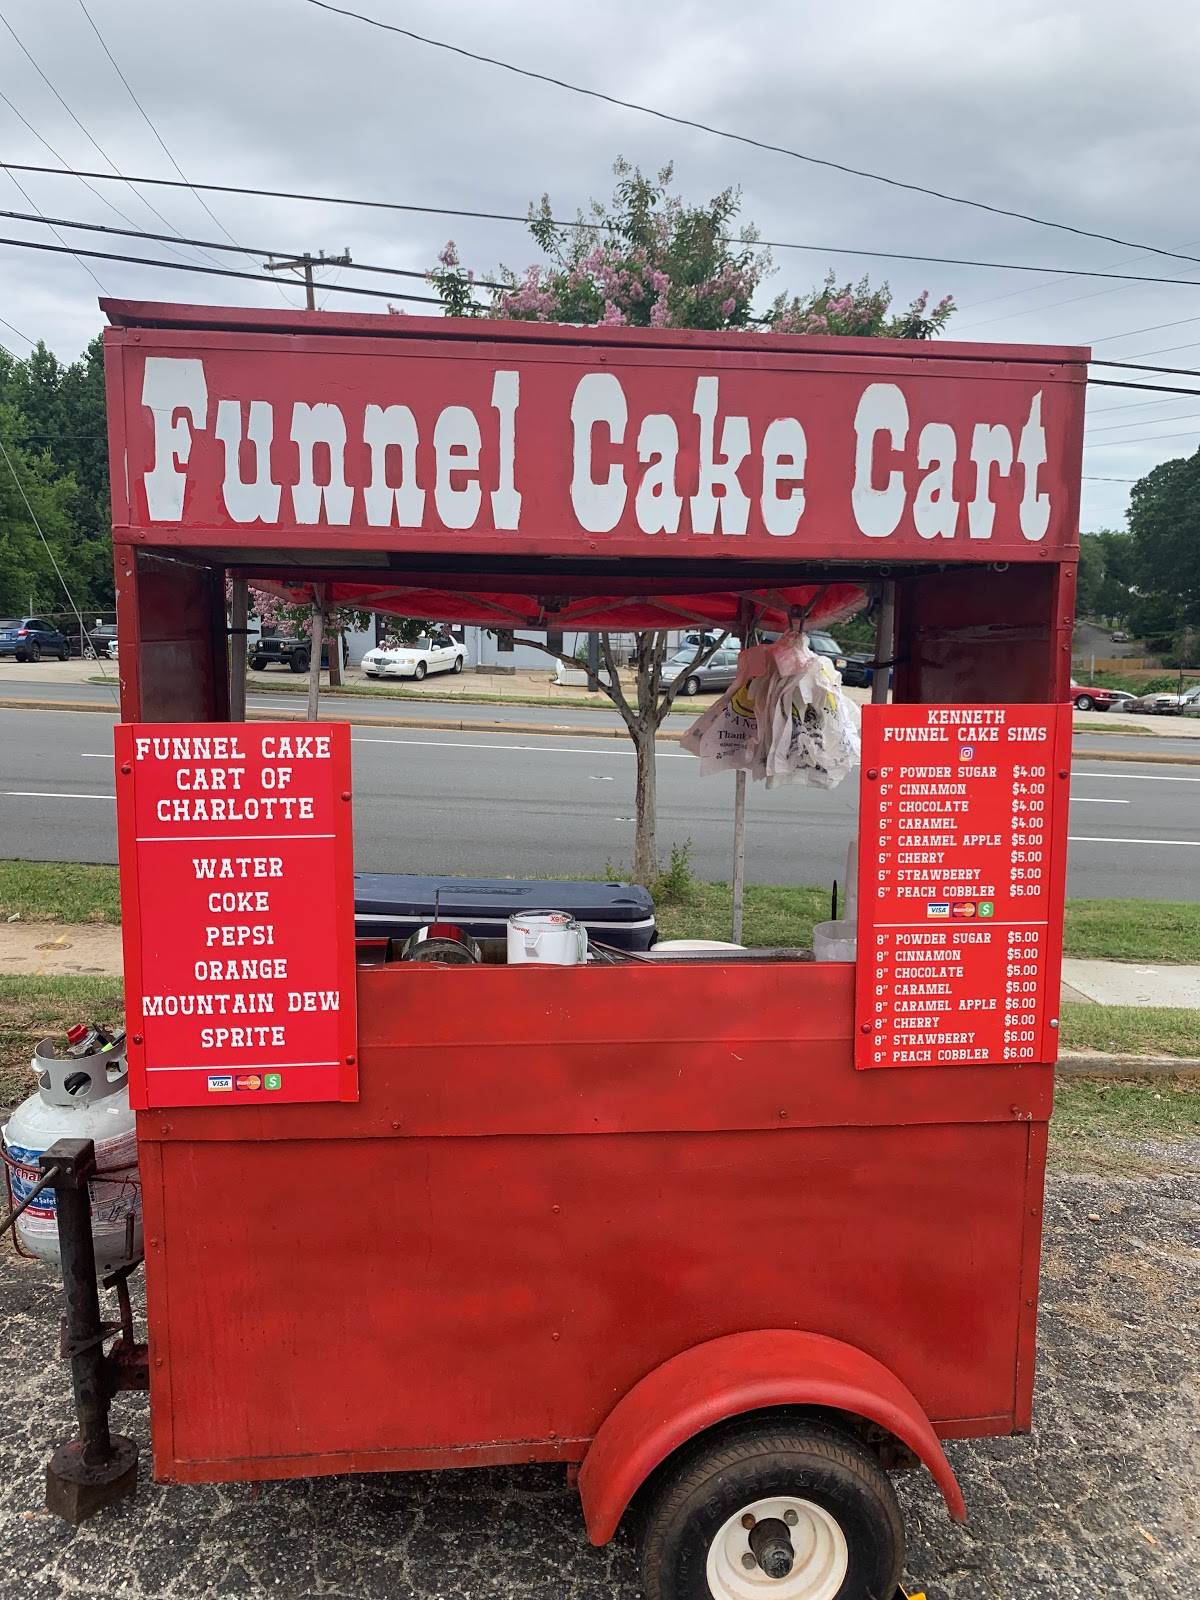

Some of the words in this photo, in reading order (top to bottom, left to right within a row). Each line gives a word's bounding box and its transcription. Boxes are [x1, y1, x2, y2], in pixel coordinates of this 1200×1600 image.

[142, 357, 521, 530] Funnel
[570, 373, 807, 536] Cake
[852, 383, 1050, 541] Cart
[927, 709, 1005, 724] KENNETH
[883, 727, 948, 741] FUNNEL
[957, 727, 998, 741] CAKE
[1007, 727, 1046, 741] SIMS
[135, 737, 245, 760] FUNNEL
[261, 736, 330, 758] CAKE
[176, 767, 244, 790] CART
[261, 767, 292, 788] OF
[899, 766, 951, 777] POWDER
[957, 766, 996, 777] SUGAR
[1012, 764, 1044, 778] $4.00
[899, 783, 966, 794] CINNAMON
[1012, 781, 1044, 795] $4.00
[157, 797, 313, 821] CHARLOTTE
[898, 800, 968, 812] CHOCOLATE
[1011, 799, 1043, 812] $4.00
[898, 817, 957, 829] CARAMEL
[1011, 816, 1043, 829] $4.00
[897, 834, 956, 846] CARAMEL
[962, 834, 1001, 845] APPLE
[1011, 833, 1042, 846] $5.00
[897, 852, 944, 863] CHERRY
[1010, 850, 1041, 863] $5.00
[192, 857, 283, 878] WATER
[897, 868, 980, 880] STRAWBERRY
[1010, 866, 1041, 880] $5.00
[896, 886, 936, 897] PEACH
[942, 885, 994, 896] COBBLER
[1009, 883, 1040, 897] $5.00
[208, 891, 269, 912] COKE
[205, 925, 273, 946] PEPSI
[895, 933, 946, 944] POWDER
[952, 932, 991, 943] SUGAR
[1007, 930, 1038, 943] $5.00
[895, 949, 960, 961] CINNAMON
[1007, 947, 1037, 960] $5.00
[194, 958, 287, 980] ORANGE
[894, 966, 963, 978] CHOCOLATE
[1006, 963, 1037, 977] $5.00
[894, 983, 952, 995] CARAMEL
[1005, 980, 1036, 993] $5.00
[142, 992, 273, 1015] MOUNTAIN
[287, 991, 339, 1011] DEW
[893, 999, 951, 1011] CARAMEL
[958, 998, 996, 1010] APPLE
[1005, 997, 1035, 1010] $6.00
[893, 1016, 939, 1028] CHERRY
[1004, 1013, 1034, 1026] $6.00
[200, 1026, 285, 1047] SPRITE
[893, 1032, 975, 1045] STRAWBERRY
[1003, 1029, 1034, 1043] $6.00
[892, 1050, 931, 1061] PEACH
[937, 1048, 988, 1060] COBBLER
[1003, 1046, 1033, 1059] $6.00
